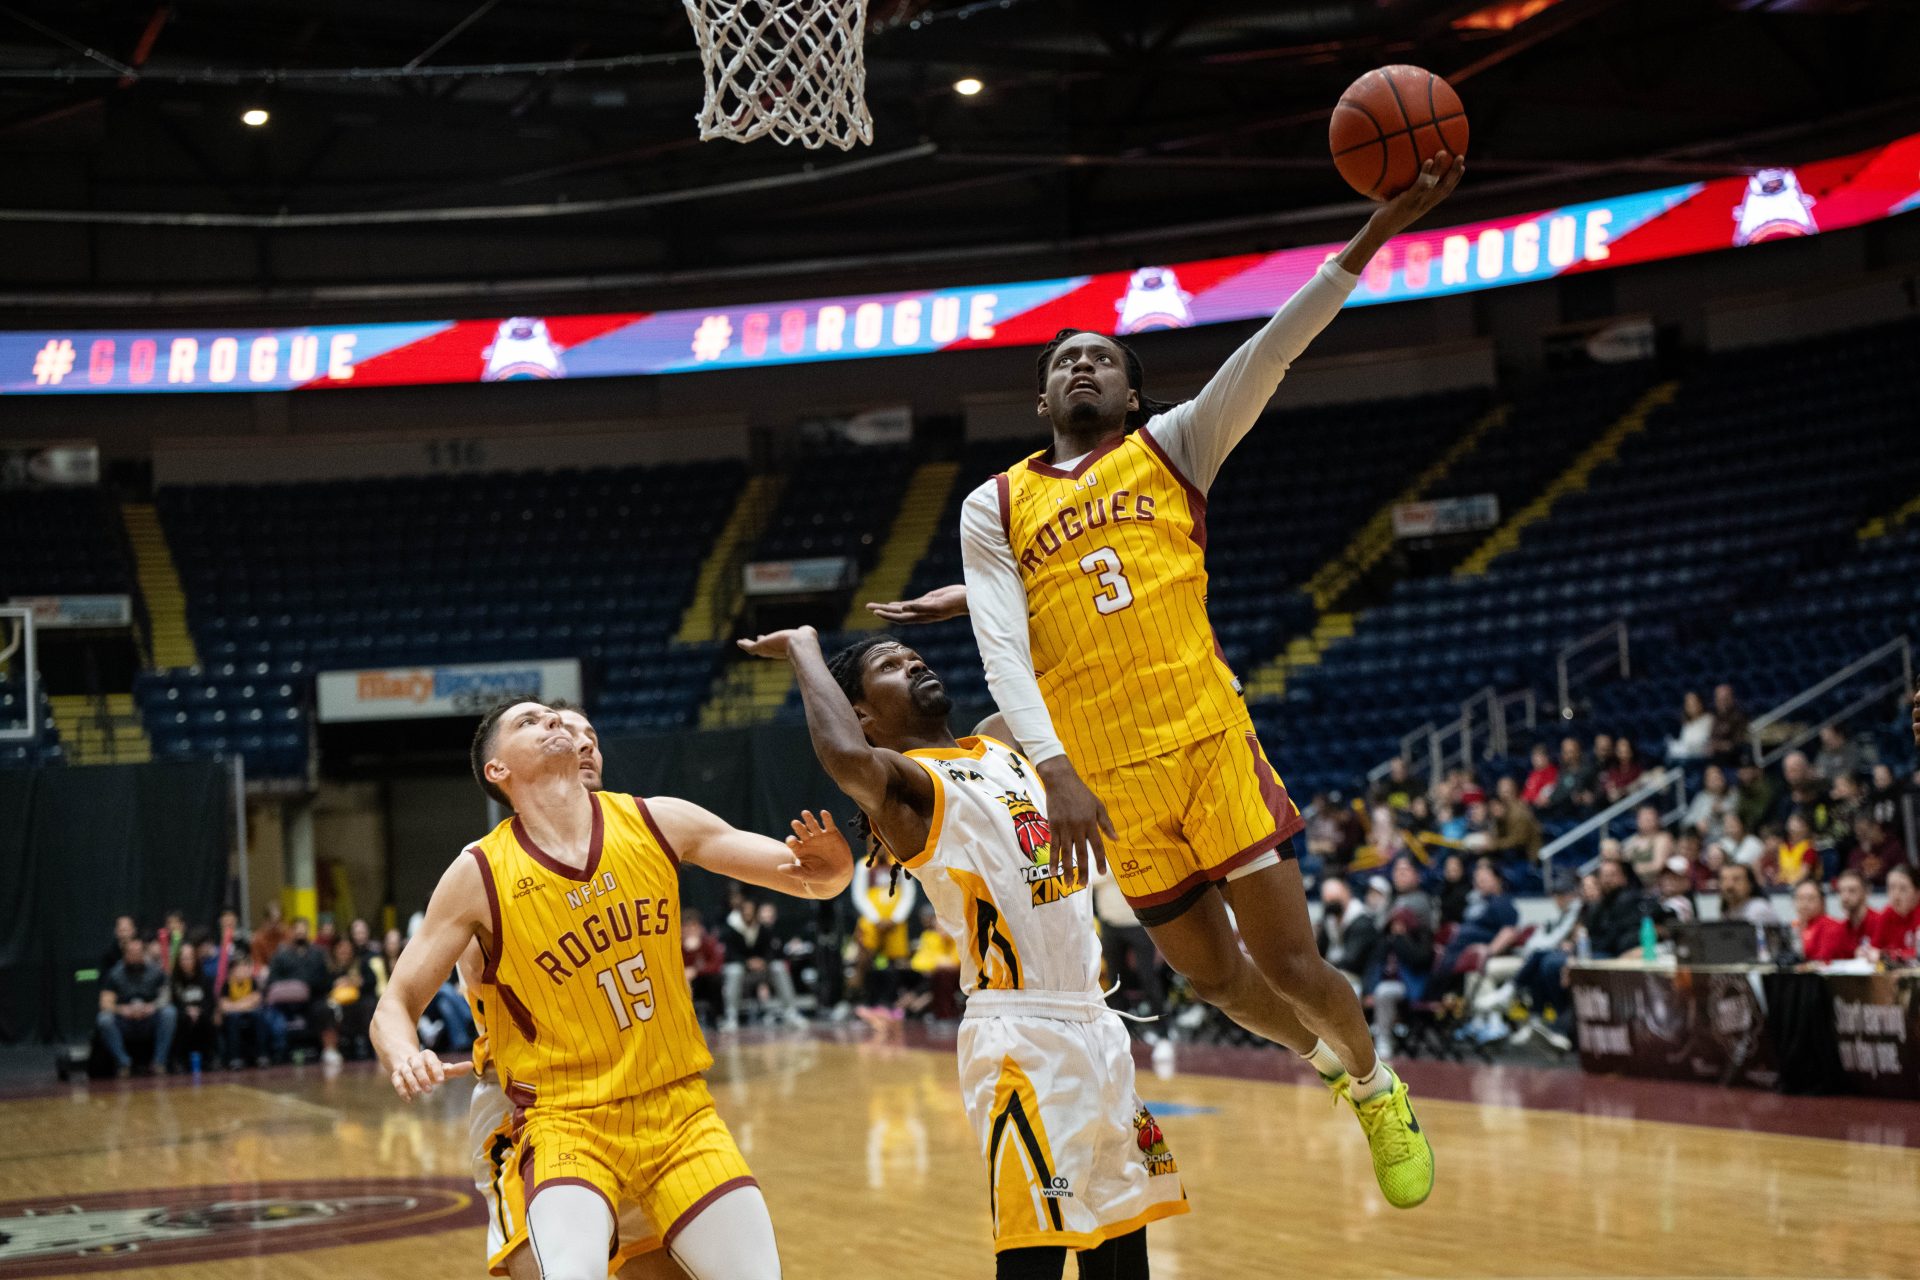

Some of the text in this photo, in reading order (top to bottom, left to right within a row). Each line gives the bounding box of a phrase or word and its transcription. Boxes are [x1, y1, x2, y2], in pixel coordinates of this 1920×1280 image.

[1316, 208, 1613, 294] GOROGUE
[1019, 490, 1156, 576] ROGUES
[1078, 545, 1135, 616] 3
[564, 870, 618, 911] NFLD
[533, 898, 670, 987] ROGUES
[596, 950, 656, 1033] 15
